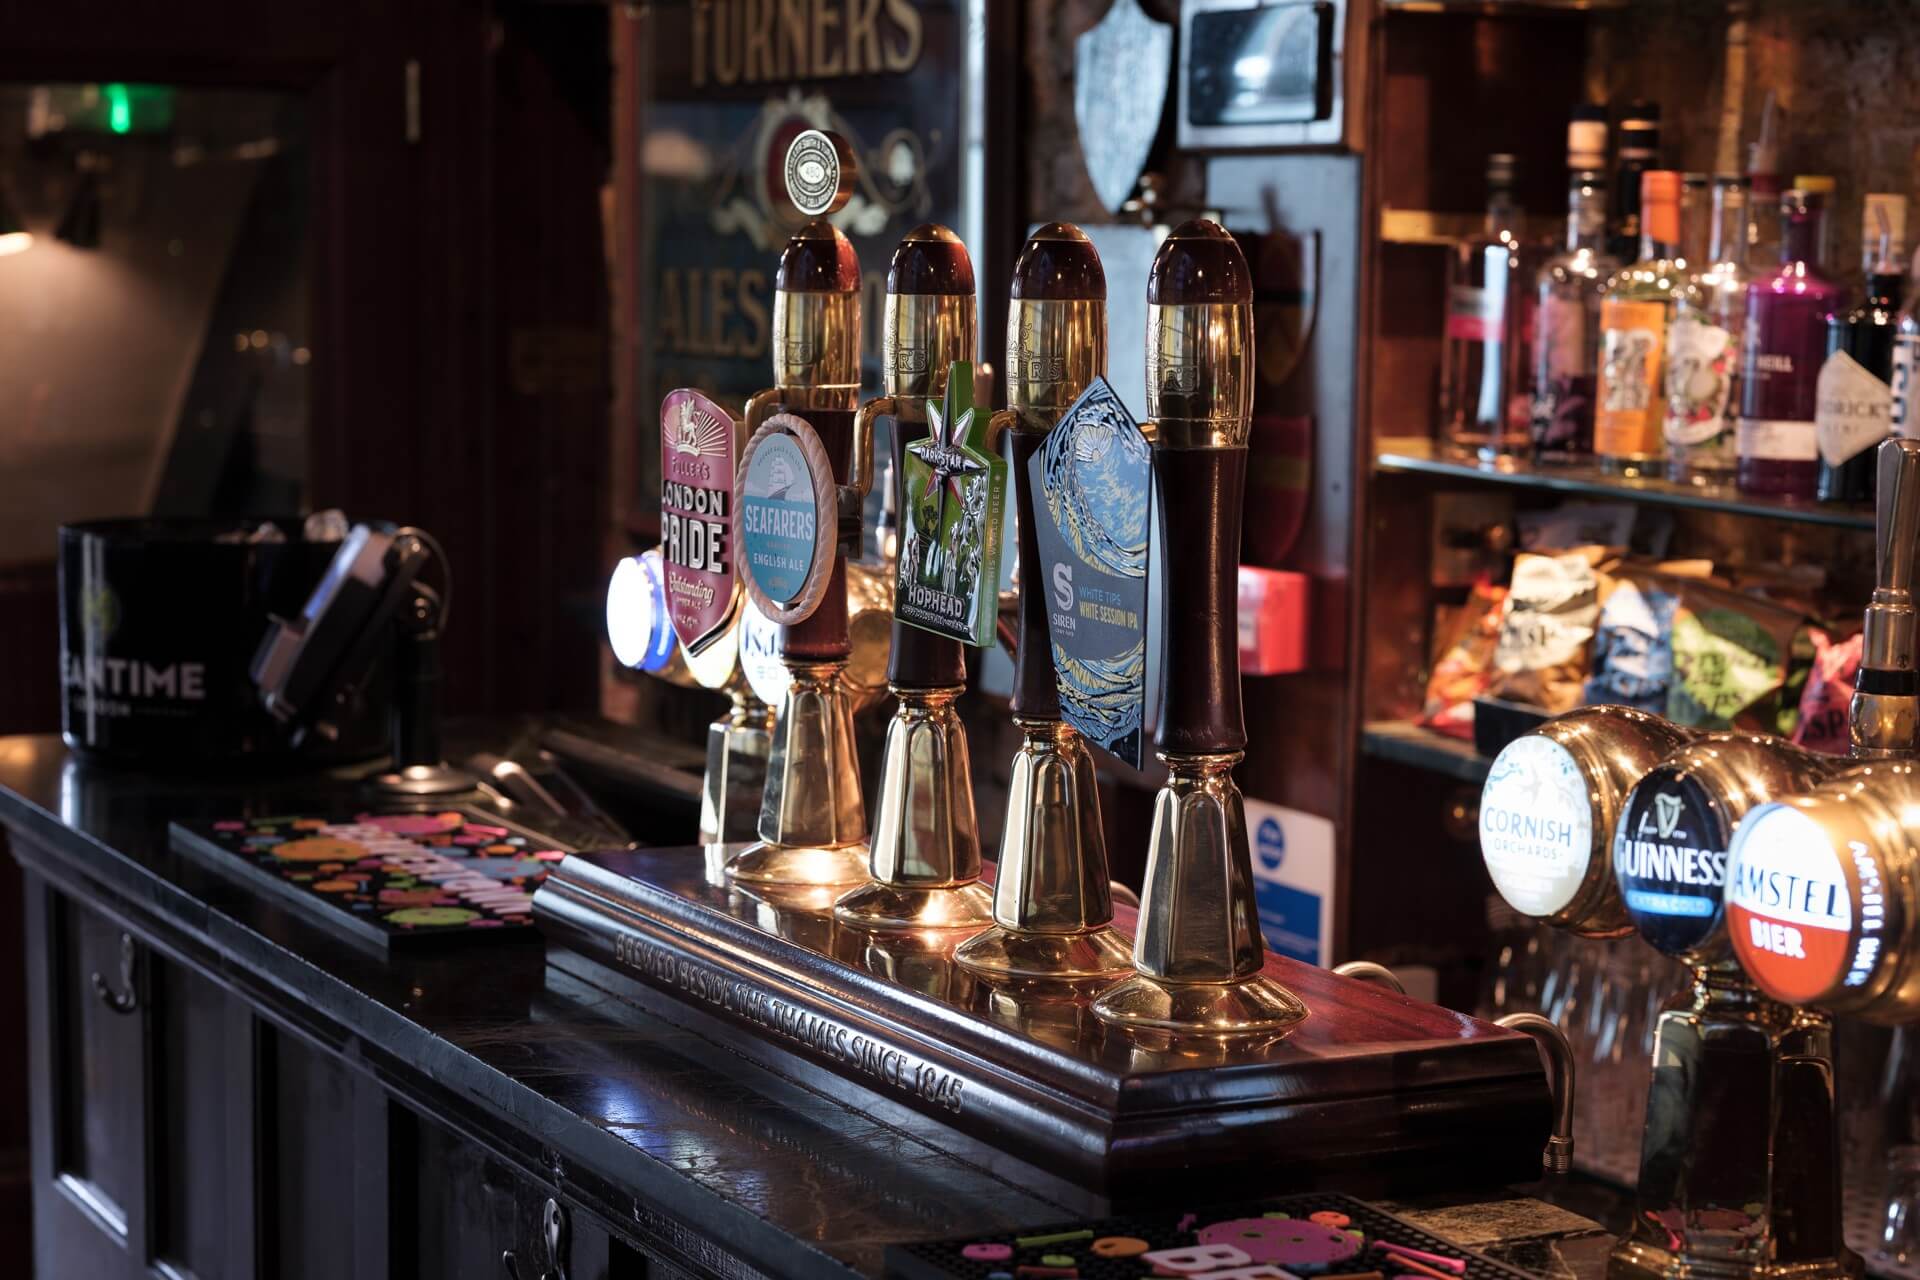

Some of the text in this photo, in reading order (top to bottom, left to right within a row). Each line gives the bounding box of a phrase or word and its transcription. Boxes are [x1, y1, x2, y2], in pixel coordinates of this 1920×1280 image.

[920, 446, 962, 470] DARK STAR
[992, 486, 1000, 514] BEER
[745, 503, 814, 541] SEAFARERS
[661, 511, 723, 575] PRIDE
[753, 552, 804, 571] ENGLISH ALE
[908, 585, 964, 618] HOPHEAD
[1079, 584, 1121, 606] WHITE TIPS
[1052, 612, 1076, 631] SIREN
[1079, 601, 1138, 630] WHITE SESSION IPA
[1484, 806, 1571, 848] CORNISH
[1734, 862, 1845, 919] AMSTEL
[1749, 917, 1806, 959] BIER
[735, 983, 768, 1027] THE
[772, 998, 848, 1062] THAMES
[851, 1035, 908, 1090] SINCE
[915, 1062, 963, 1114] 1845
